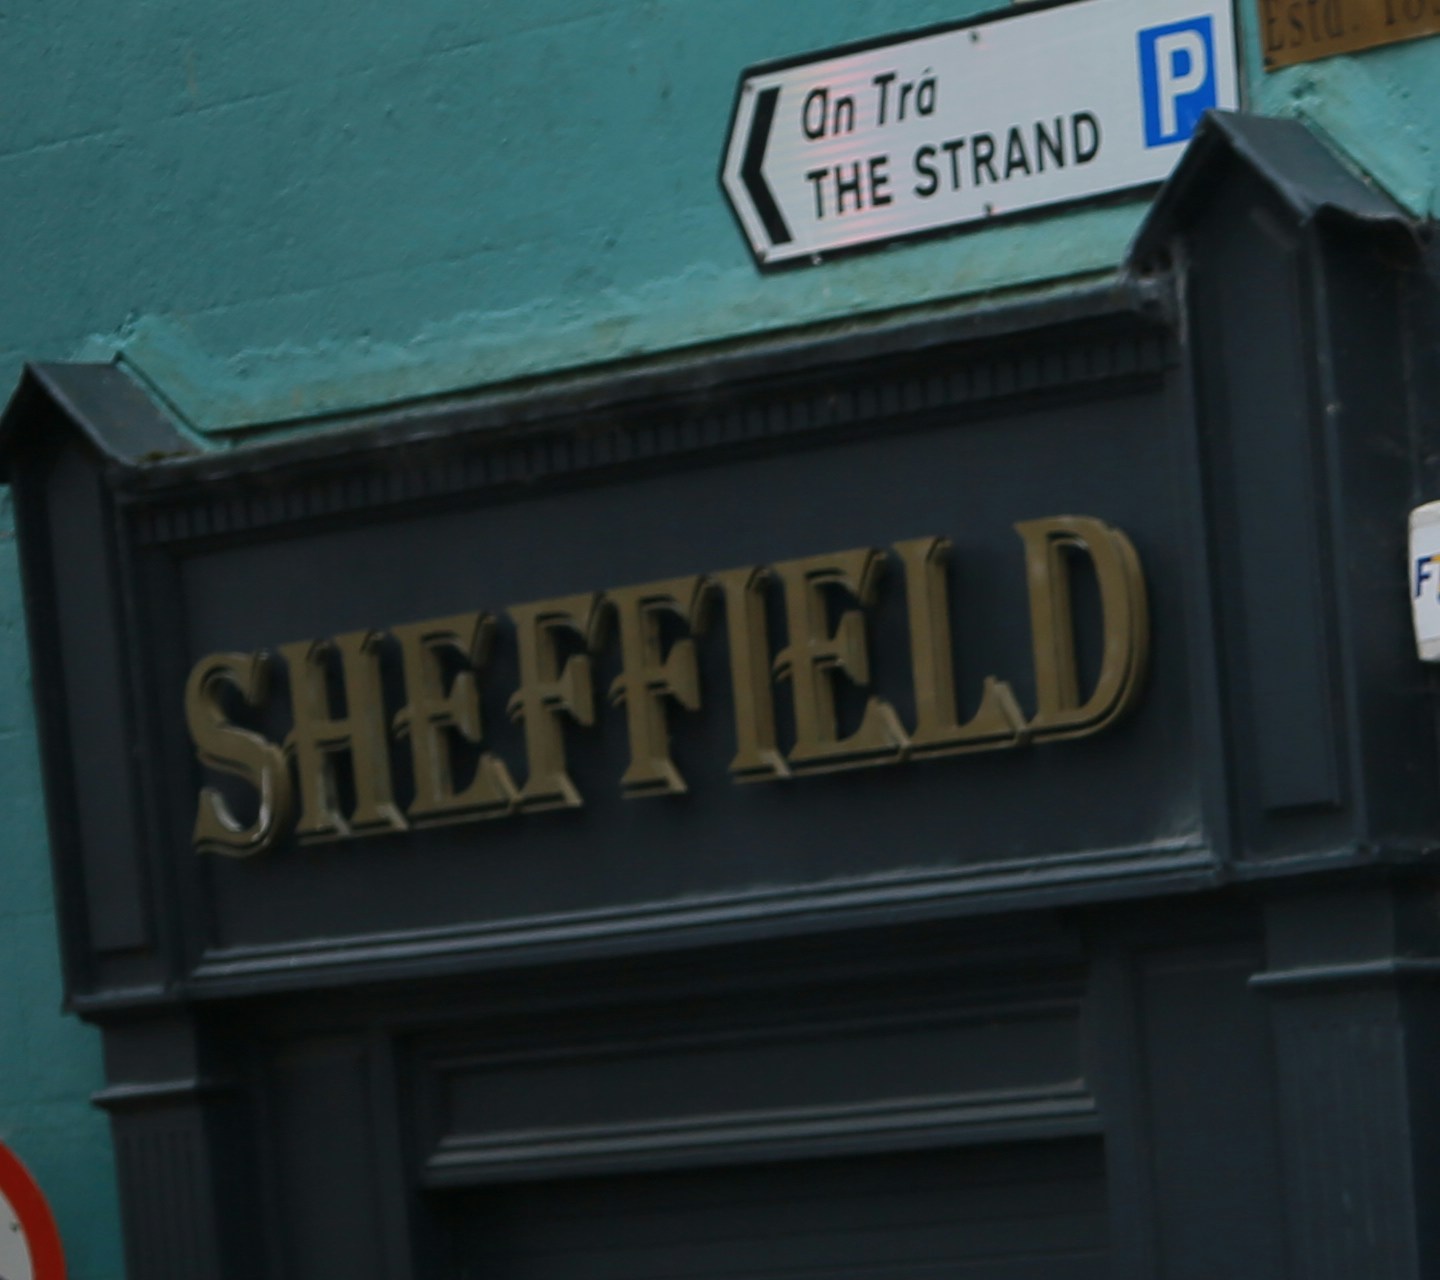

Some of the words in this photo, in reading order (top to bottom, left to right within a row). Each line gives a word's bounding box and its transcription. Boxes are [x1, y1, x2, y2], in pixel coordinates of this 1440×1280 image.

[801, 84, 857, 142] An
[872, 66, 937, 127] Trá
[1154, 28, 1208, 139] P
[804, 154, 893, 221] THE
[913, 108, 1103, 198] STRAND
[184, 513, 1149, 859] SHEFFIELD
